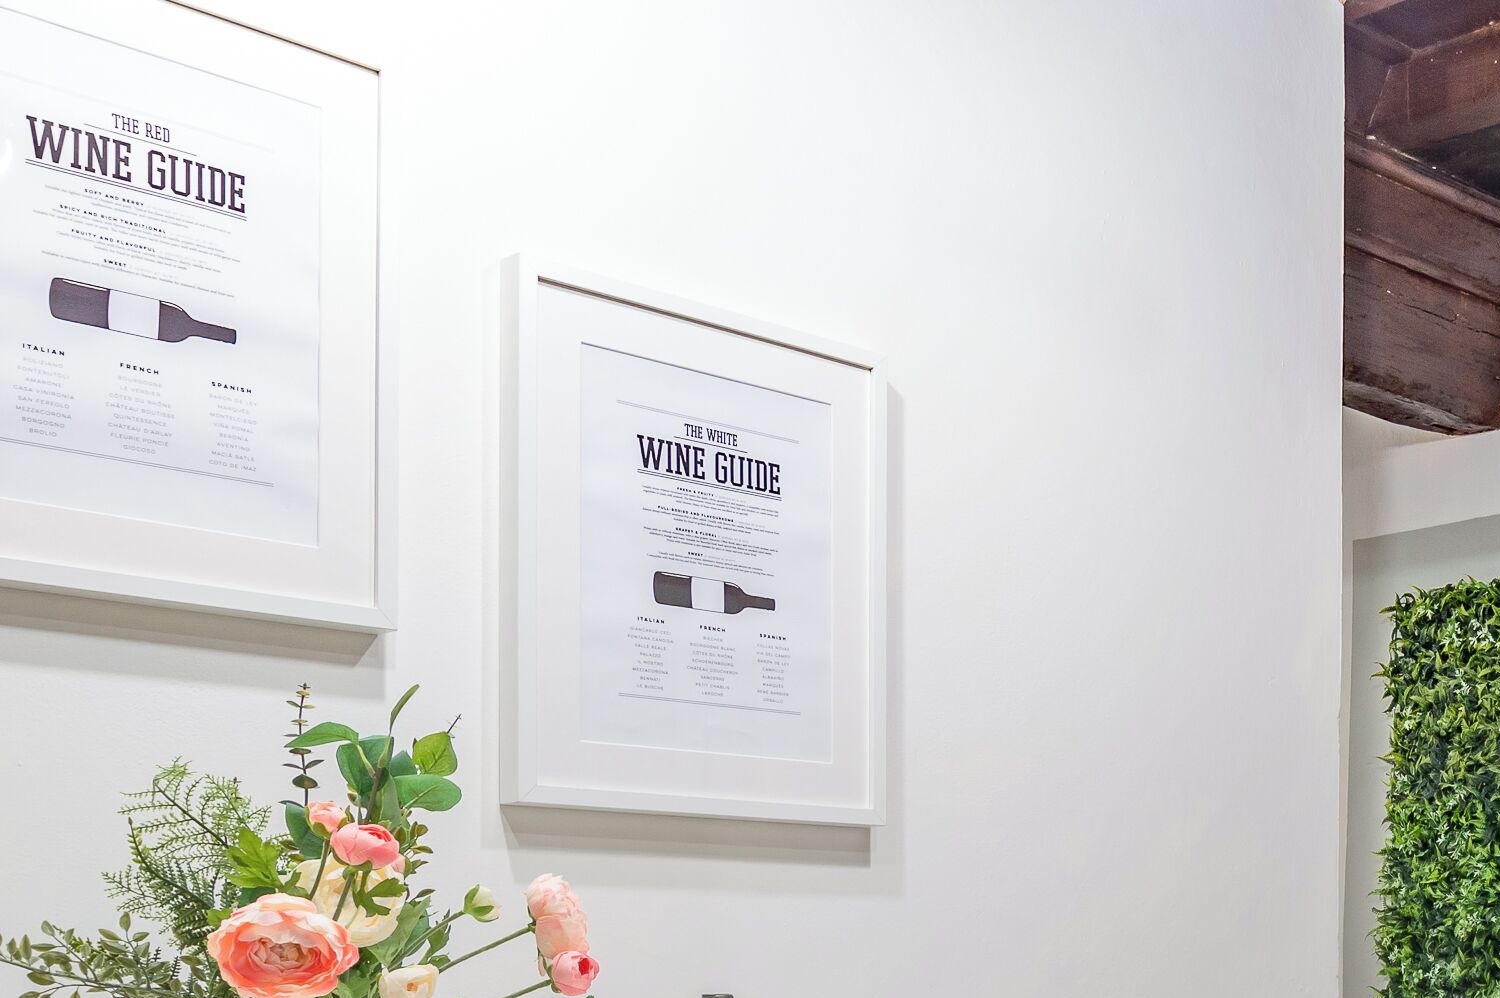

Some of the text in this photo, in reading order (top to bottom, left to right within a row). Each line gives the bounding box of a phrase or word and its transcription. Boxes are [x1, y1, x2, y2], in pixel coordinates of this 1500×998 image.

[112, 113, 170, 143] THE RED
[26, 115, 132, 183] WINE
[148, 150, 246, 214] GUIDE
[122, 198, 144, 206] BERRY
[60, 204, 80, 212] SPICY
[120, 219, 166, 234] TRADITIONAL
[71, 228, 96, 238] FRUITY
[116, 240, 155, 253] FLAVORFUL
[104, 259, 127, 267] SWEET
[22, 343, 65, 356] ITALIAN
[119, 362, 159, 375] FRENCH
[211, 381, 252, 394] SPANISH
[684, 423, 738, 447] THE WHITE
[637, 434, 781, 495] WINE GUIDE
[637, 616, 665, 624] ITALIAN
[700, 624, 726, 632] FRENCH
[759, 633, 786, 641] SPANISH
